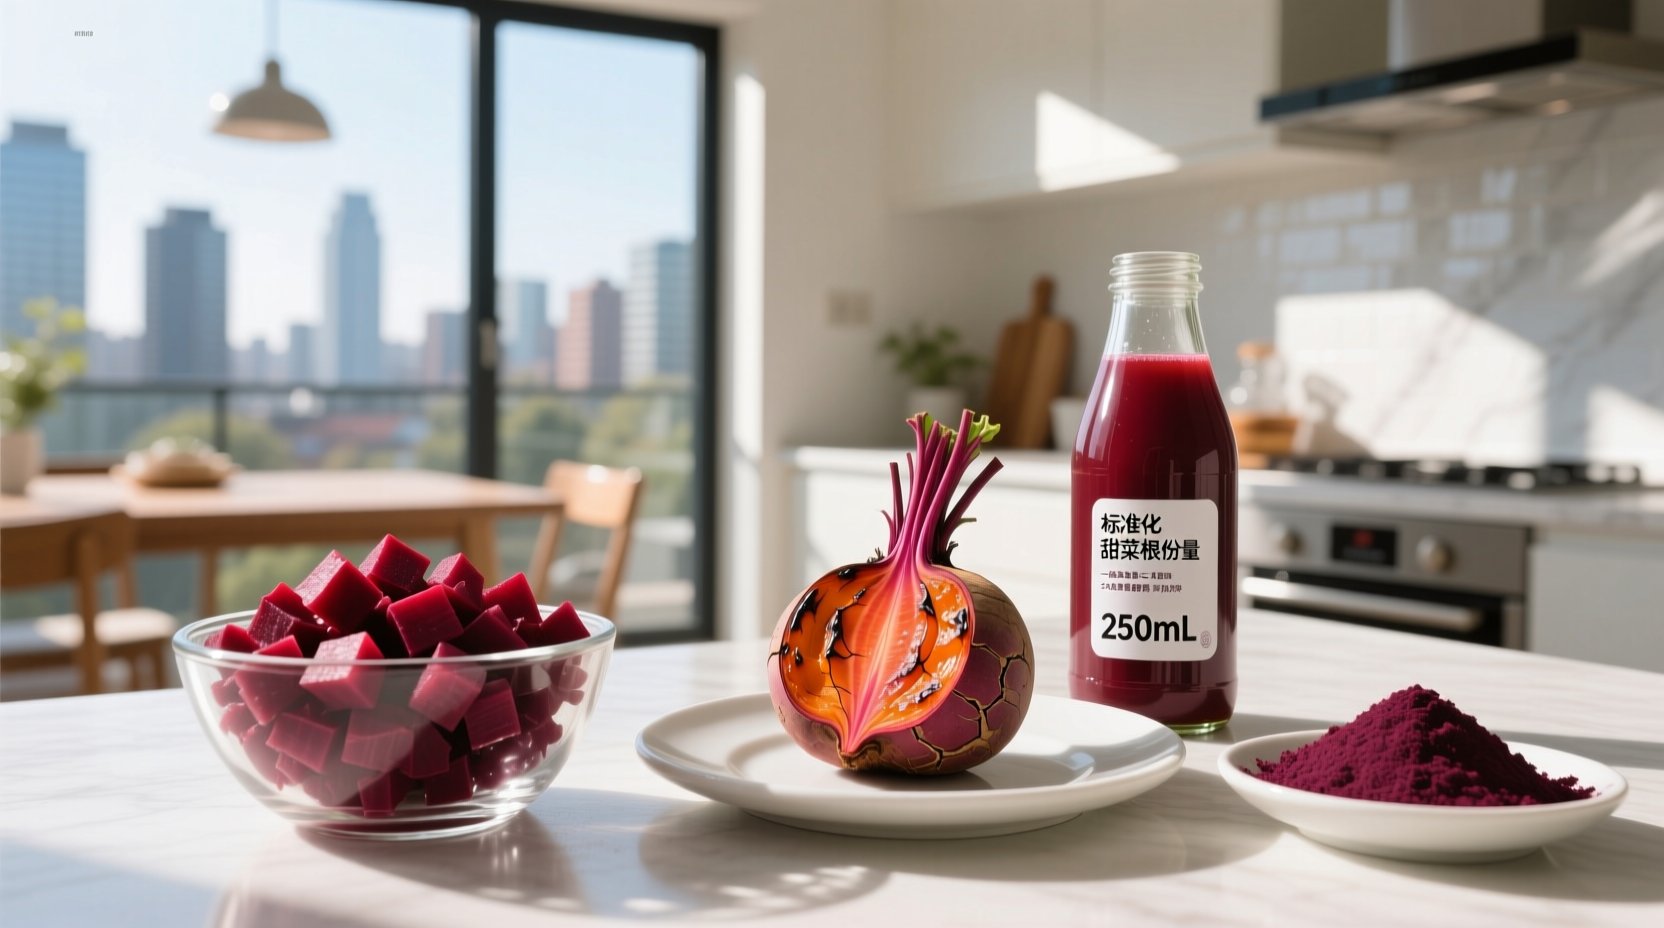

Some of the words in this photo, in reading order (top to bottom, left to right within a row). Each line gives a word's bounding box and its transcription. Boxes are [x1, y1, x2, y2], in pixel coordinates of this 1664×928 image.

[1101, 513, 1162, 535] 标准化
[1100, 538, 1200, 560] 甜菜根份量
[1101, 613, 1197, 642] 250mL
